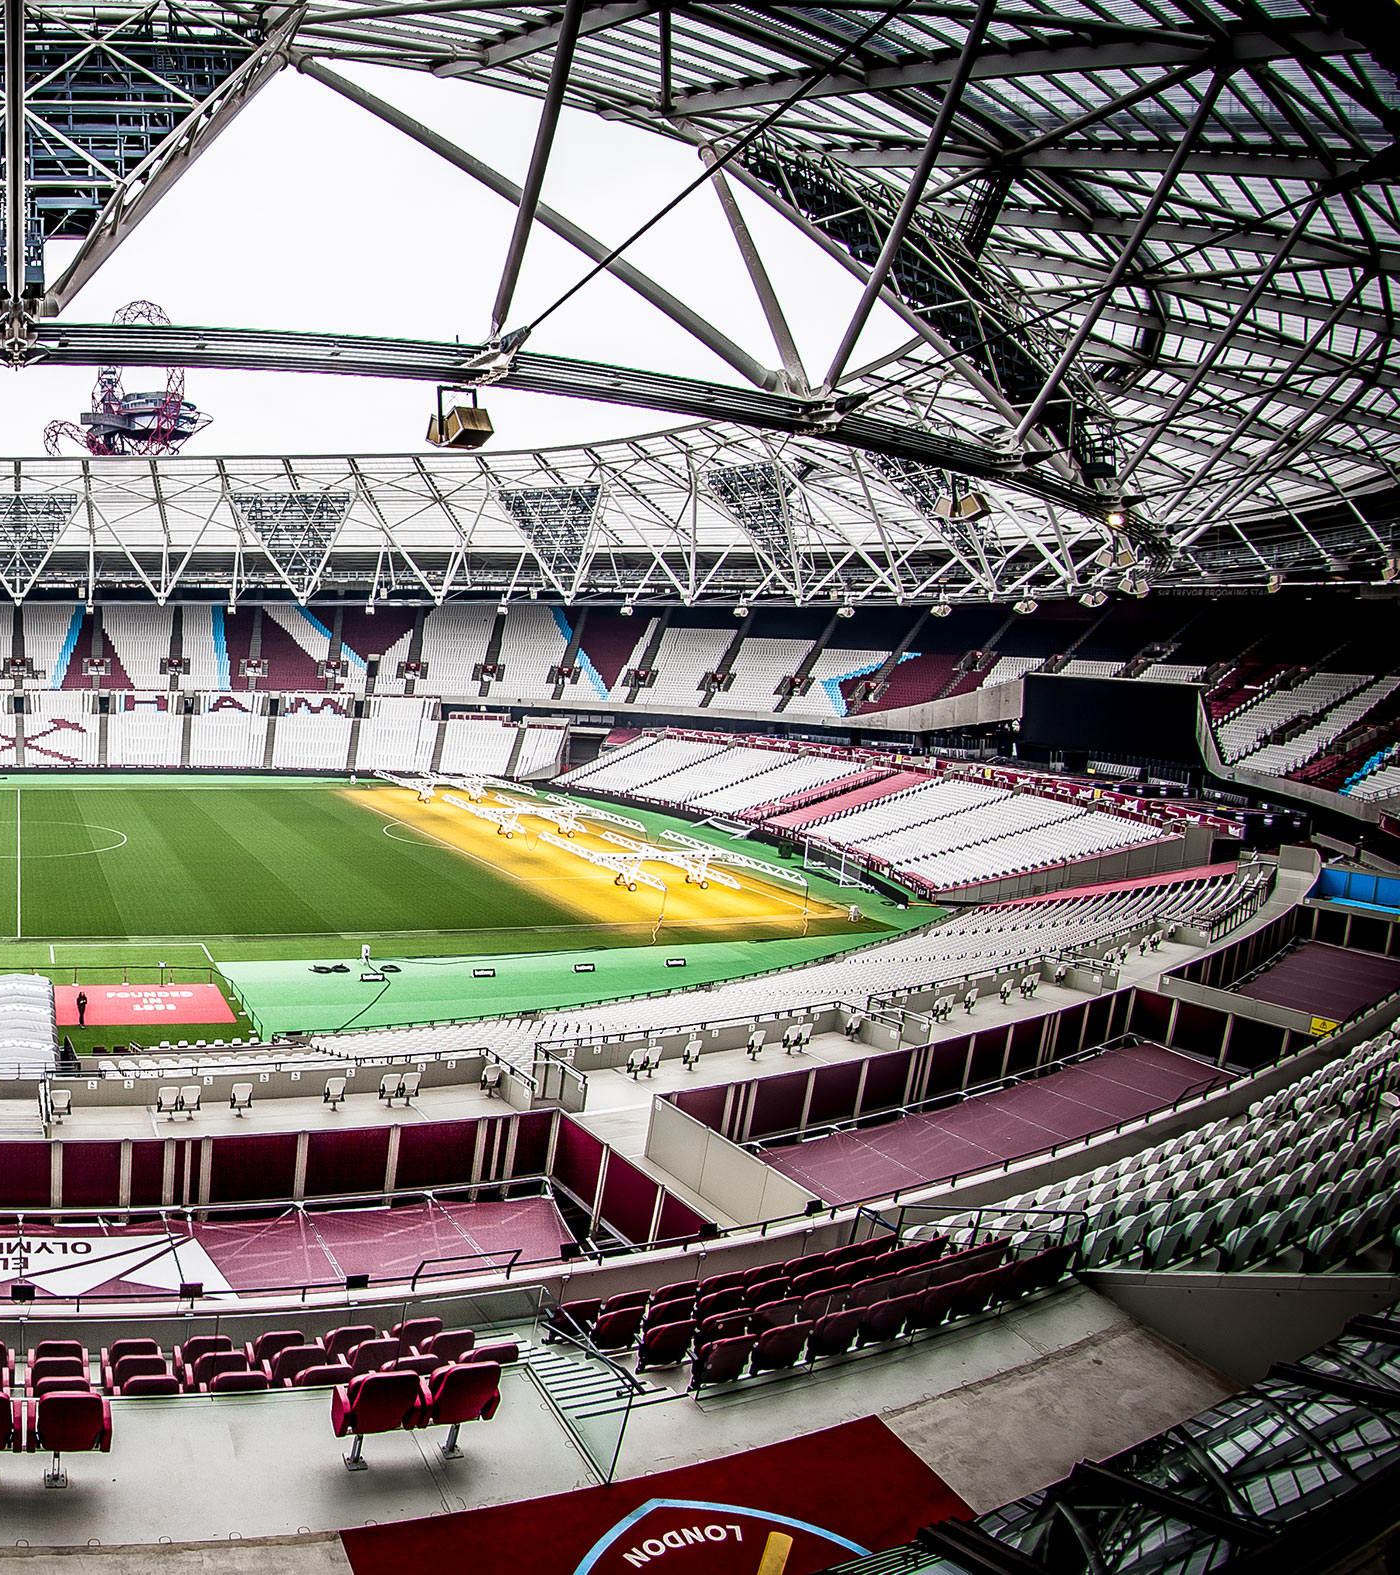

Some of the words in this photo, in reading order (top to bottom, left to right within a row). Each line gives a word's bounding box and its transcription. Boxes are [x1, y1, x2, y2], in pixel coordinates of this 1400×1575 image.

[1157, 589, 1170, 597] SIR
[1172, 589, 1203, 597] TREVOR
[1204, 588, 1249, 597] BROOKING
[119, 695, 349, 718] HAM
[622, 1524, 743, 1569] LONDON
